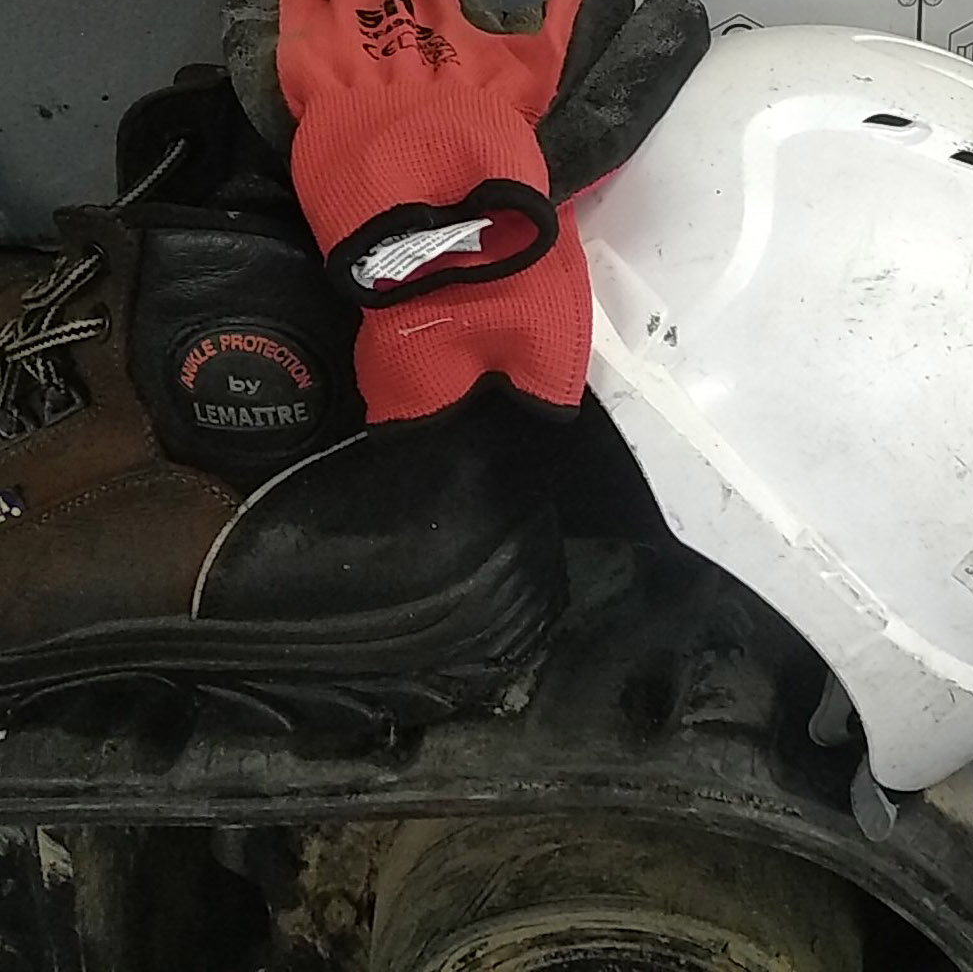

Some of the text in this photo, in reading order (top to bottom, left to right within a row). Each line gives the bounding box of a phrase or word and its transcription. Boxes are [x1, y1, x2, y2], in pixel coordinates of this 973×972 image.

[180, 333, 313, 390] ANKLE PROTECTION
[228, 375, 262, 395] by
